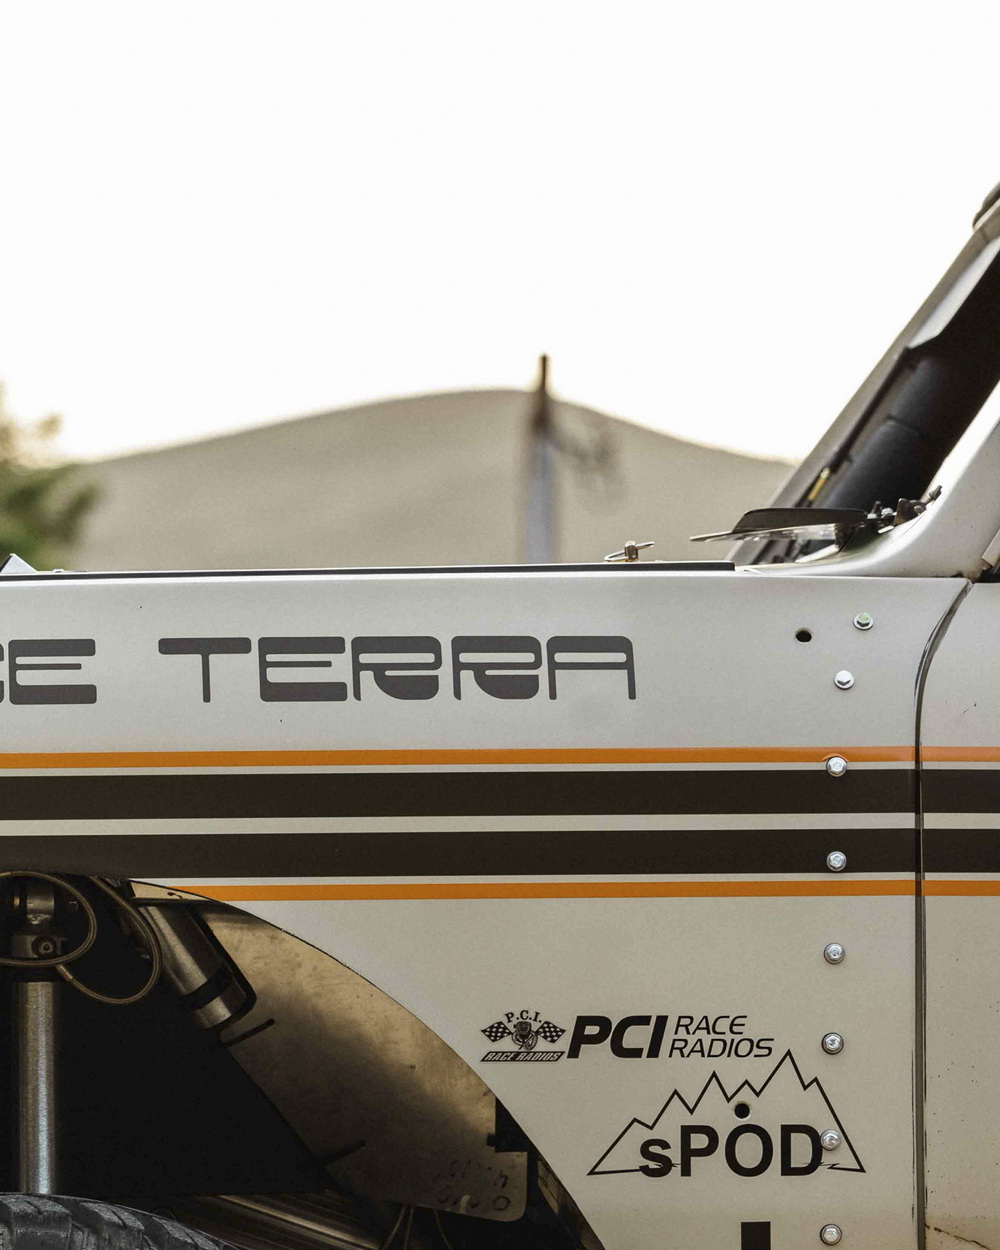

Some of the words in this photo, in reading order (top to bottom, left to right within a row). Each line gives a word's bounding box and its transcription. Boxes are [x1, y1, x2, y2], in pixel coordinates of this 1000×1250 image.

[158, 635, 637, 703] TERRA
[504, 1010, 542, 1024] P.C.I.
[674, 1015, 748, 1035] RACE
[566, 1015, 669, 1059] PCI
[668, 1038, 775, 1058] RADIOS
[639, 1123, 824, 1178] sPOD
